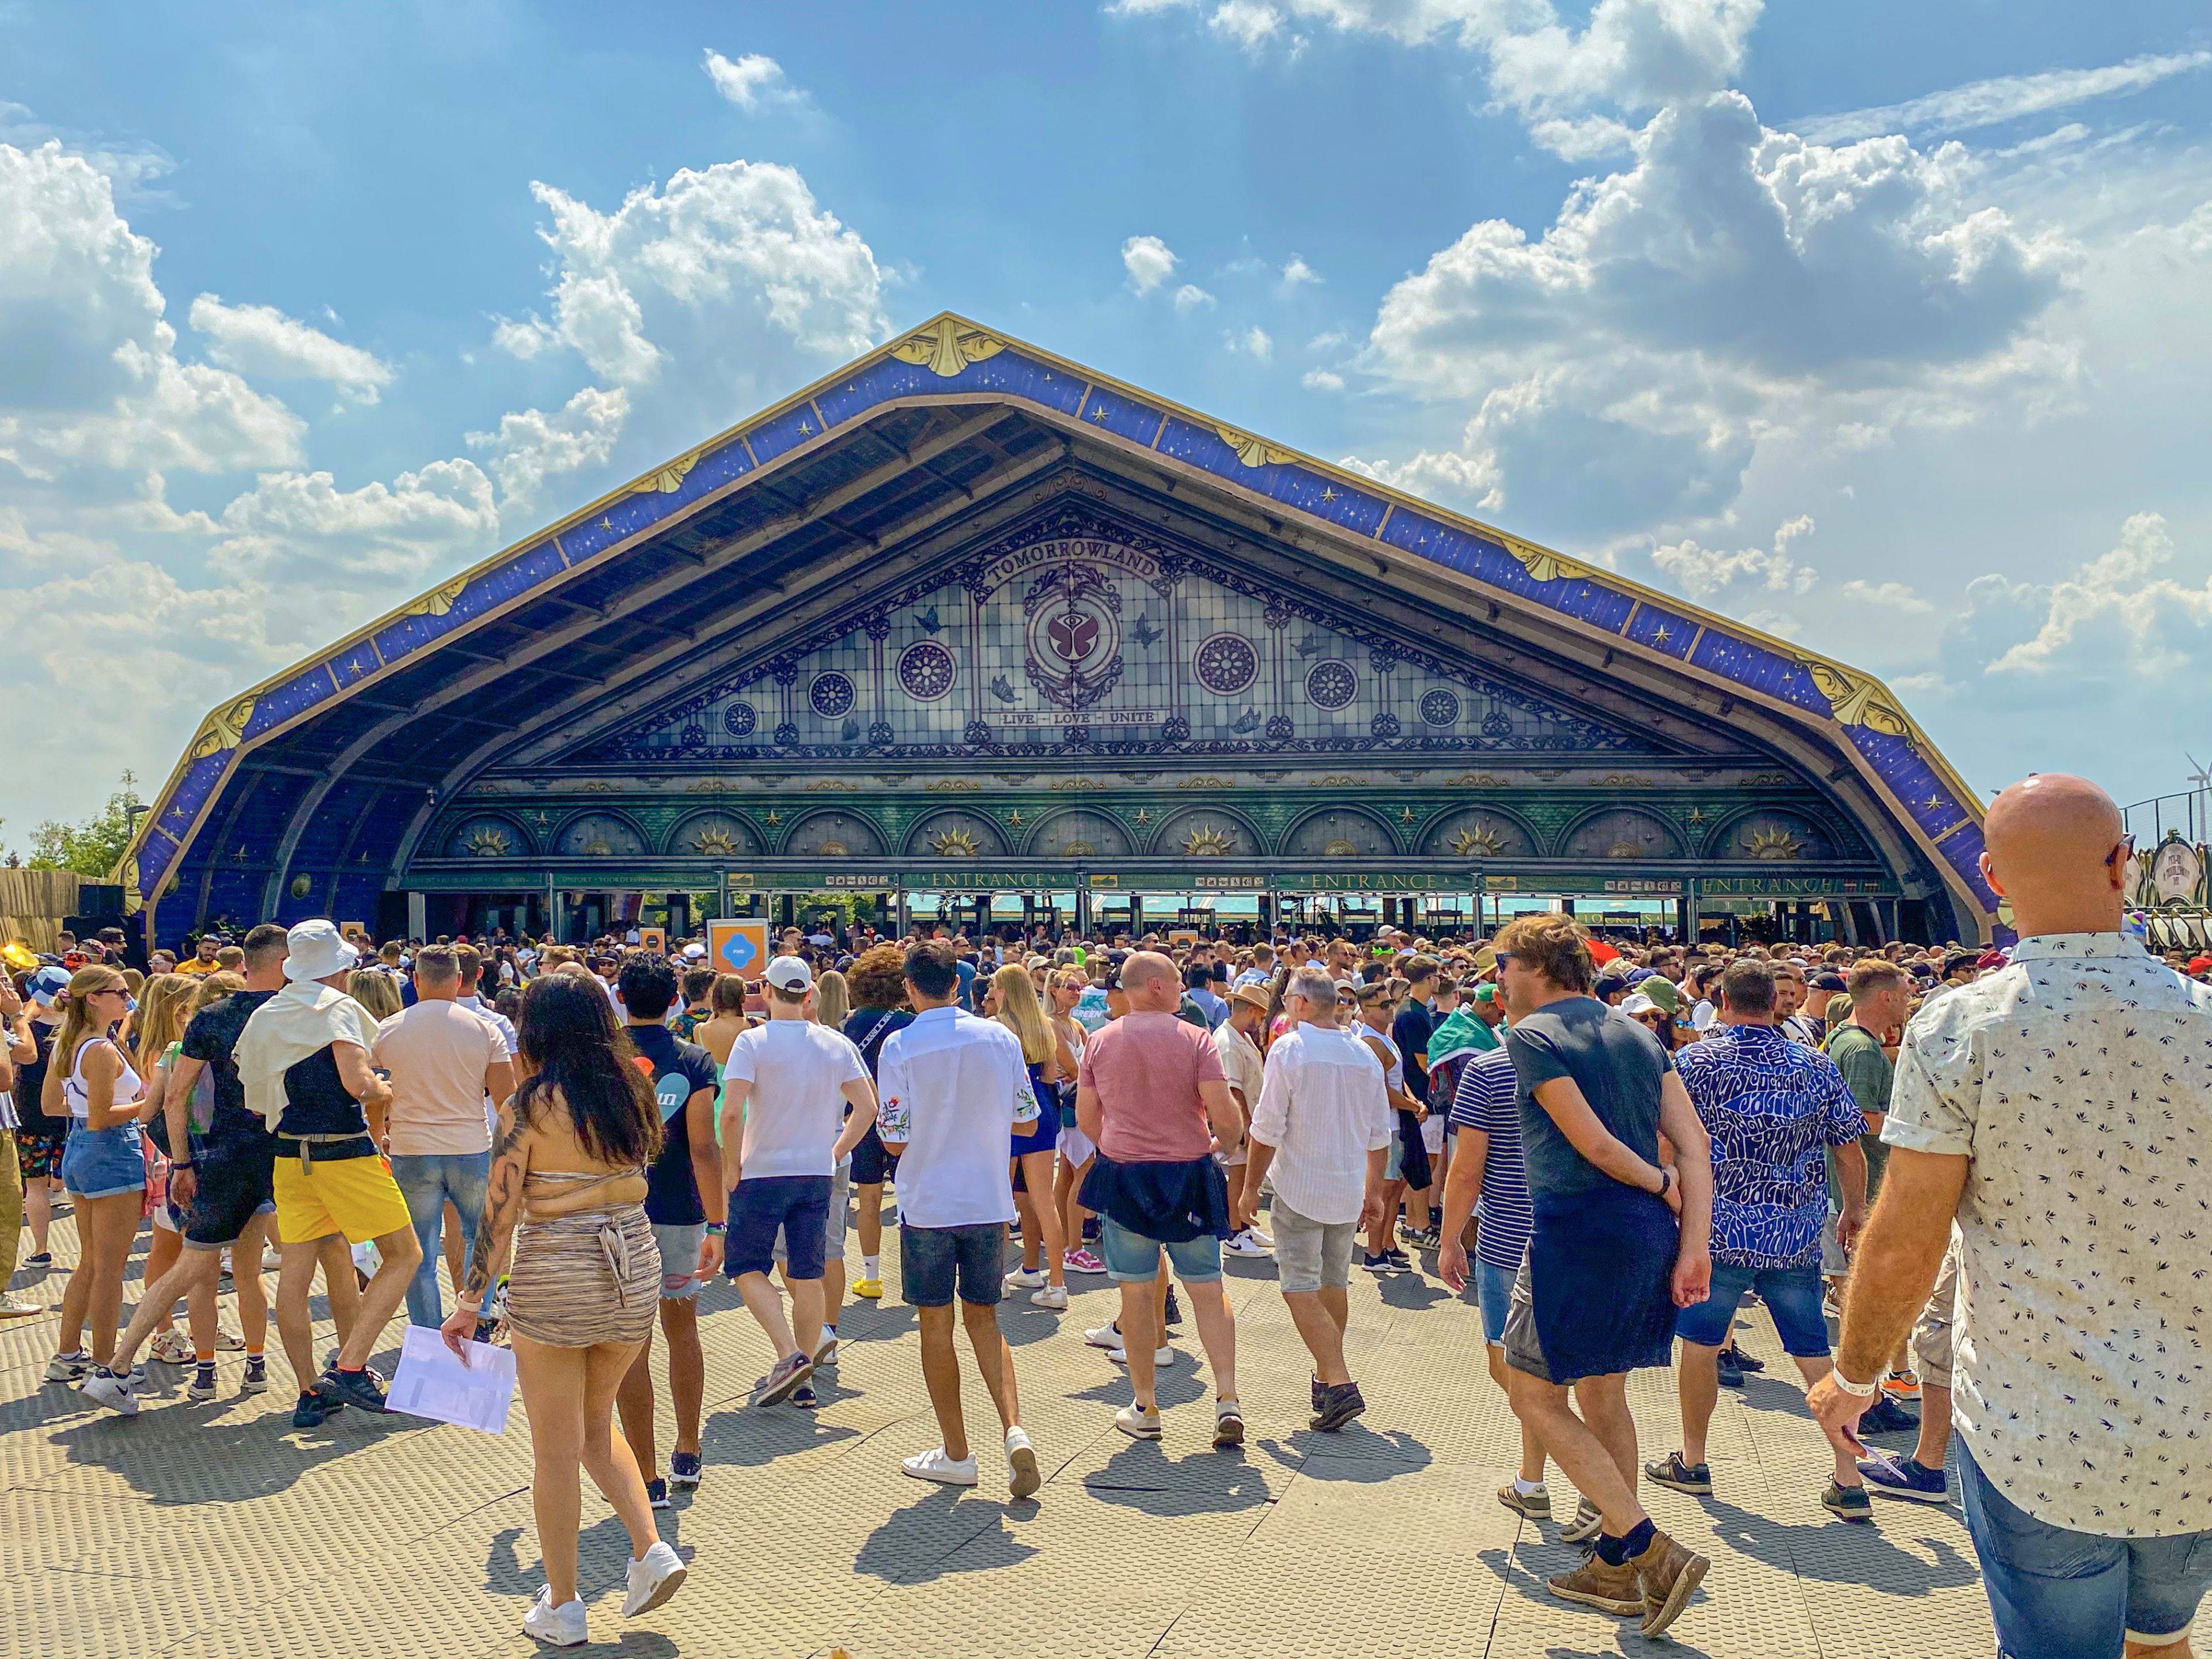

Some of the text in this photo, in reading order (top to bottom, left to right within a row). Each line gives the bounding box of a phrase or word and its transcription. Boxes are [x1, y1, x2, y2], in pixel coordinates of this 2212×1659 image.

[988, 540, 1156, 582] TOMORROWLAND
[1003, 711, 1154, 725] LIVE LOVE UNITE
[932, 873, 1046, 887] ENTRANCE
[1312, 874, 1437, 889] ENTRANCE
[1703, 878, 1832, 892] ENTRANCE
